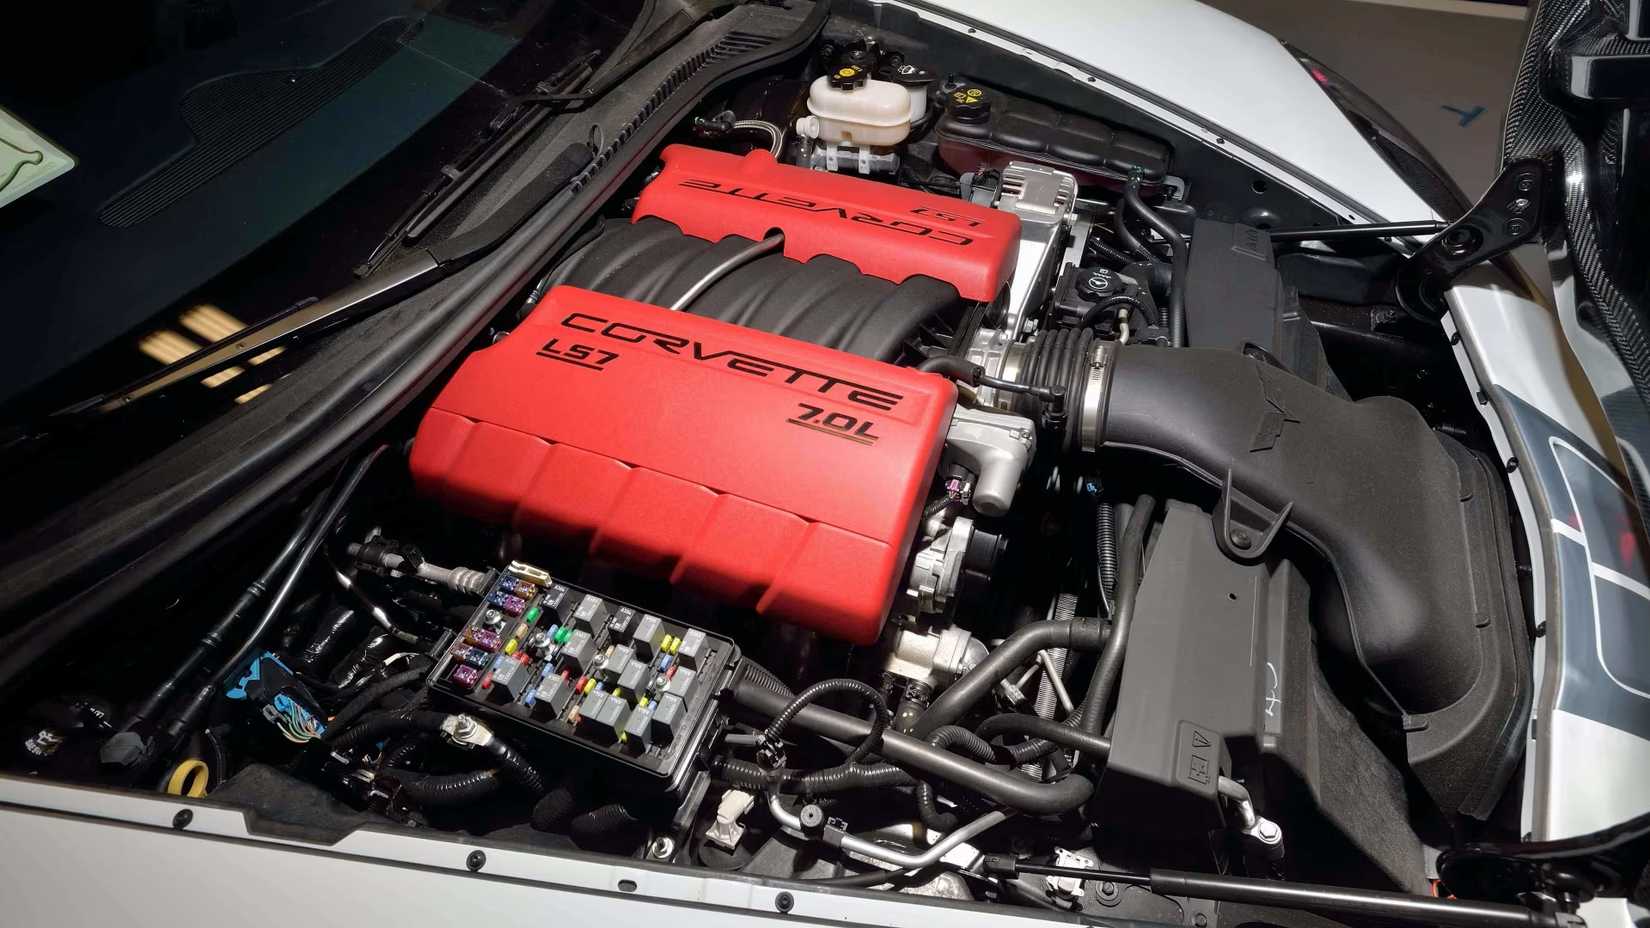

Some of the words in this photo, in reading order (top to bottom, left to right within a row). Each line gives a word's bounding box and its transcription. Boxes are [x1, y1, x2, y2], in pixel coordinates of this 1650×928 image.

[679, 178, 973, 246] CORVETTE
[909, 207, 986, 228] LS7
[540, 338, 620, 367] LS7
[561, 312, 904, 411] CORVETTE
[796, 403, 880, 441] 7.0L
